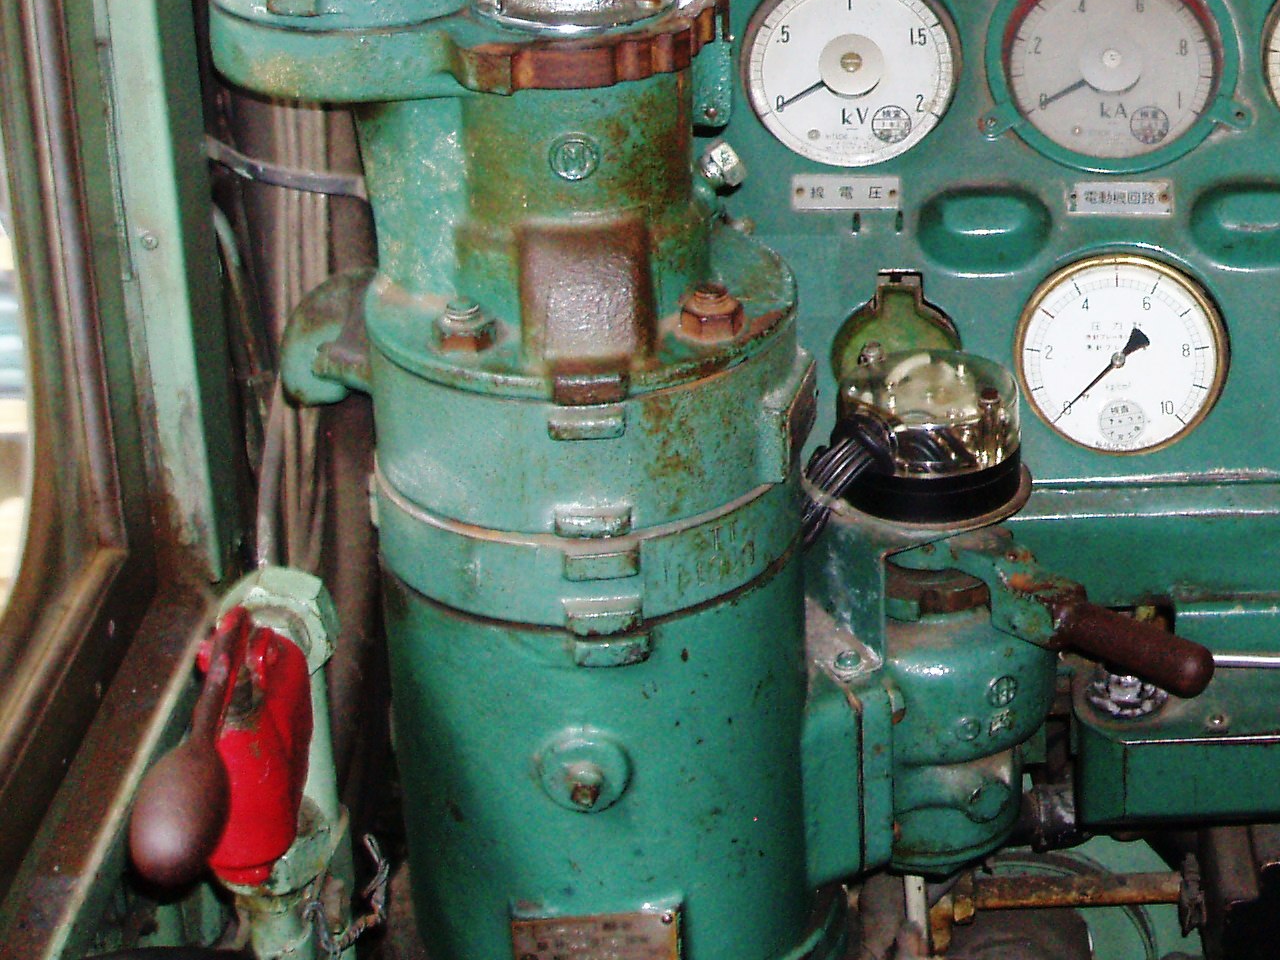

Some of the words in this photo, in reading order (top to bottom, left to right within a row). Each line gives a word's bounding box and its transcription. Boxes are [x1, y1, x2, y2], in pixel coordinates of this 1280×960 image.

[910, 27, 927, 46] 1.5
[776, 95, 785, 112] 0
[915, 94, 925, 112] 2
[1039, 93, 1048, 110] 0
[841, 108, 869, 125] kV
[1100, 102, 1127, 118] kA
[1082, 297, 1089, 311] 4
[1143, 297, 1151, 311] 6
[1045, 345, 1053, 360] 2
[1182, 343, 1190, 358] 8
[1063, 401, 1072, 415] 0
[1161, 401, 1174, 415] 10
